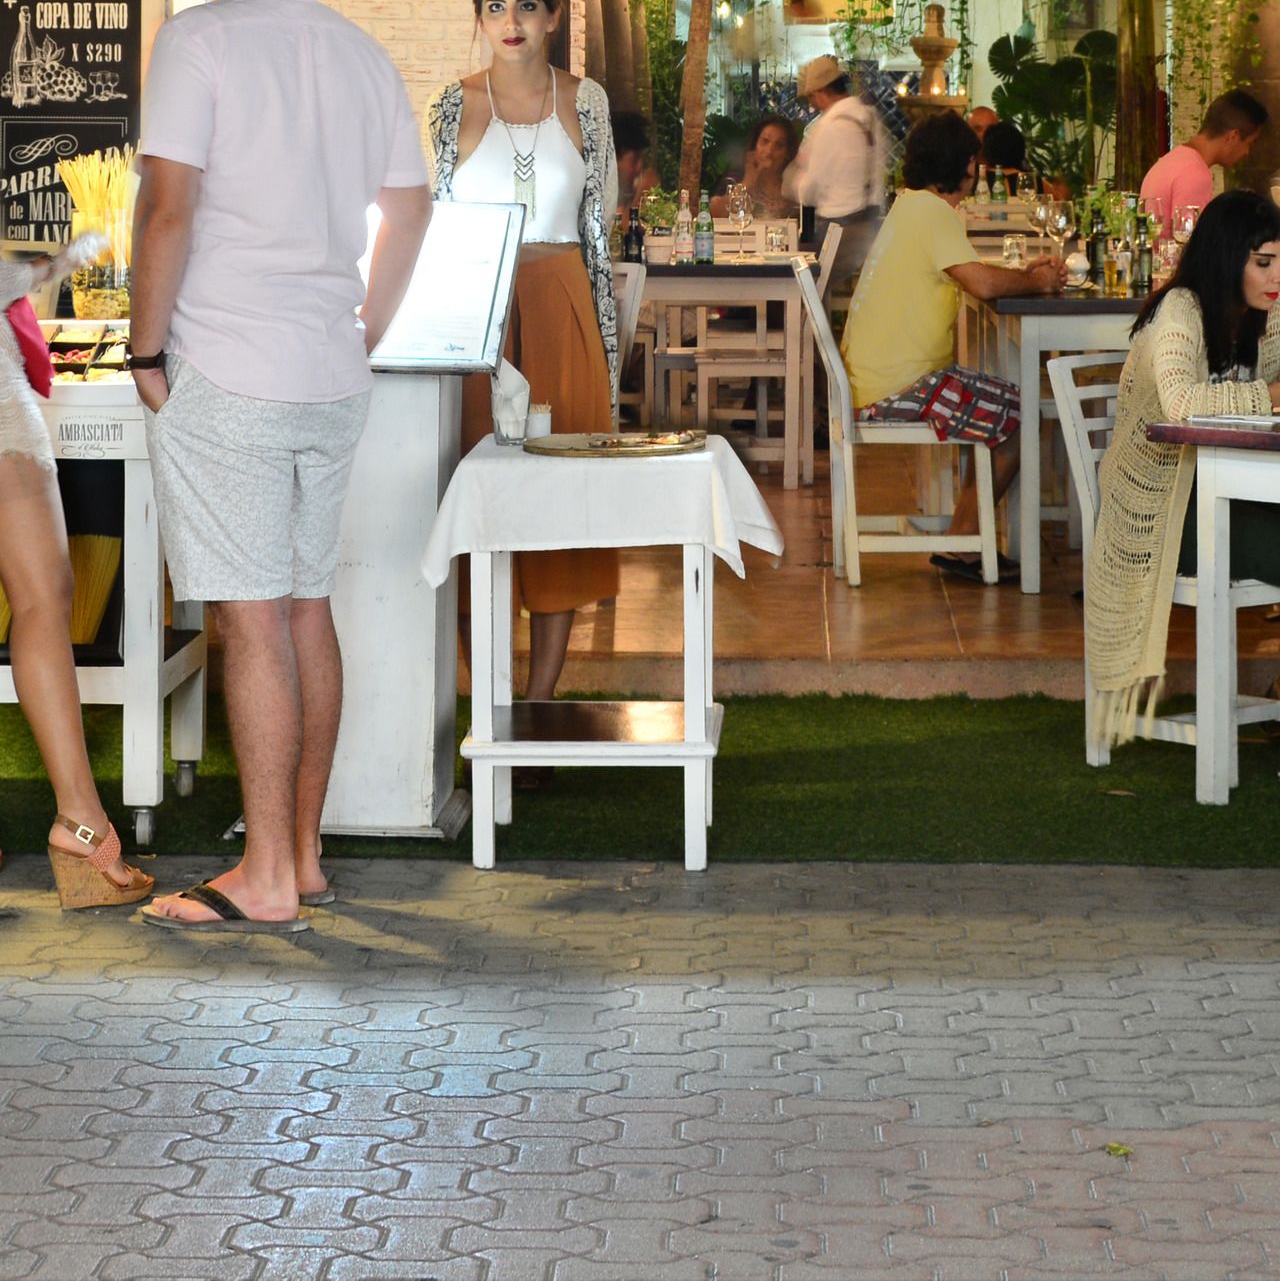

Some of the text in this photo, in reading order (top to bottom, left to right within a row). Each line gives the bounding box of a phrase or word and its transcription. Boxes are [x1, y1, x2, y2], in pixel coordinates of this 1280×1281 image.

[36, 2, 70, 29] COPA
[73, 2, 92, 29] DE
[95, 2, 128, 29] VINO
[86, 42, 122, 63] $290
[9, 200, 24, 220] de
[7, 224, 28, 241] con
[58, 423, 123, 441] AMBASCIATA
